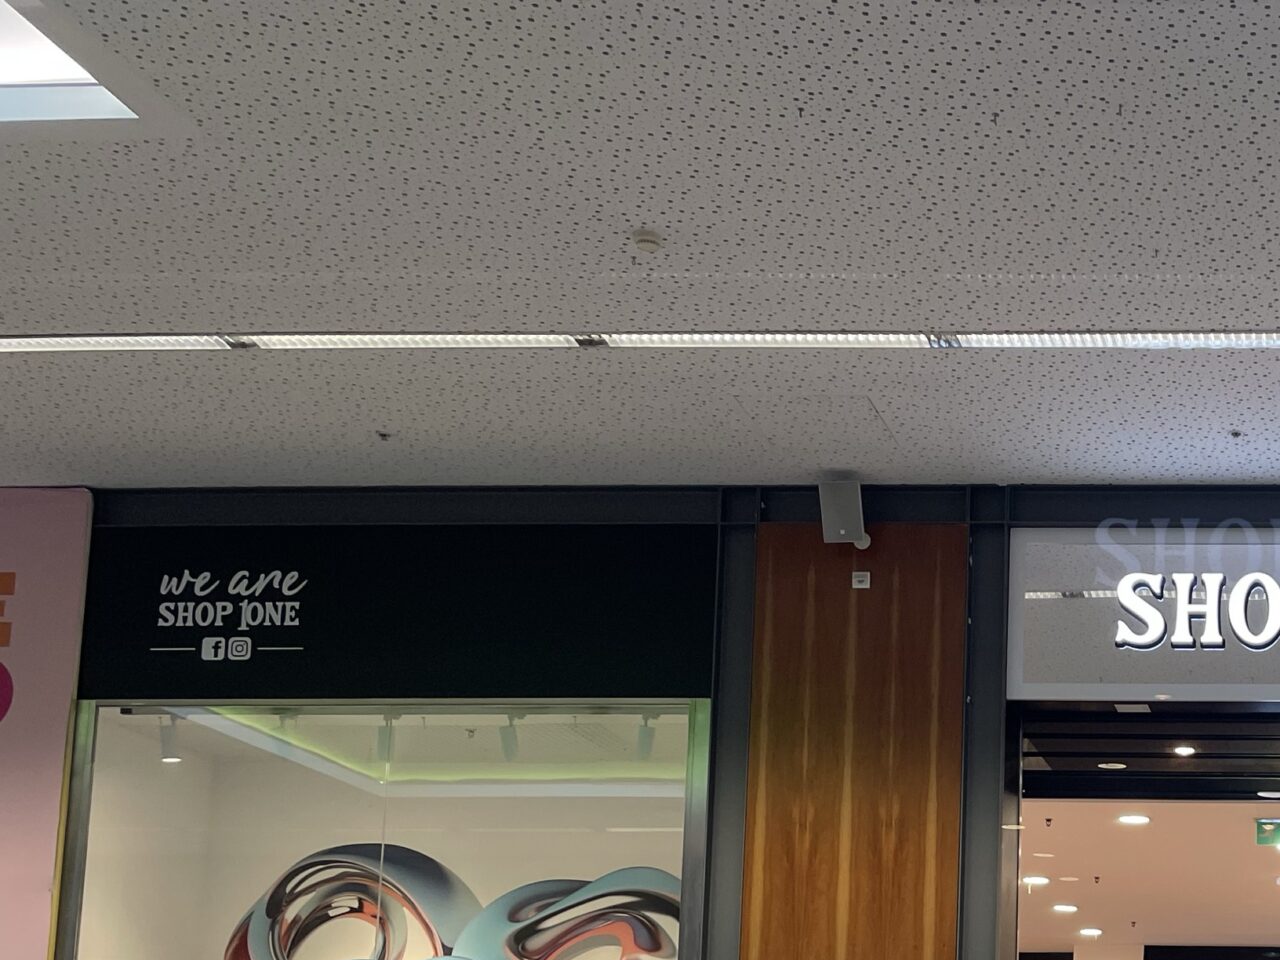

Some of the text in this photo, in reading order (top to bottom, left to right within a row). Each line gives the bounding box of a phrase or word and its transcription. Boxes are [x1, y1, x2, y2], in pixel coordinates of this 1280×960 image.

[159, 569, 308, 597] we are
[157, 602, 234, 627] SHOP
